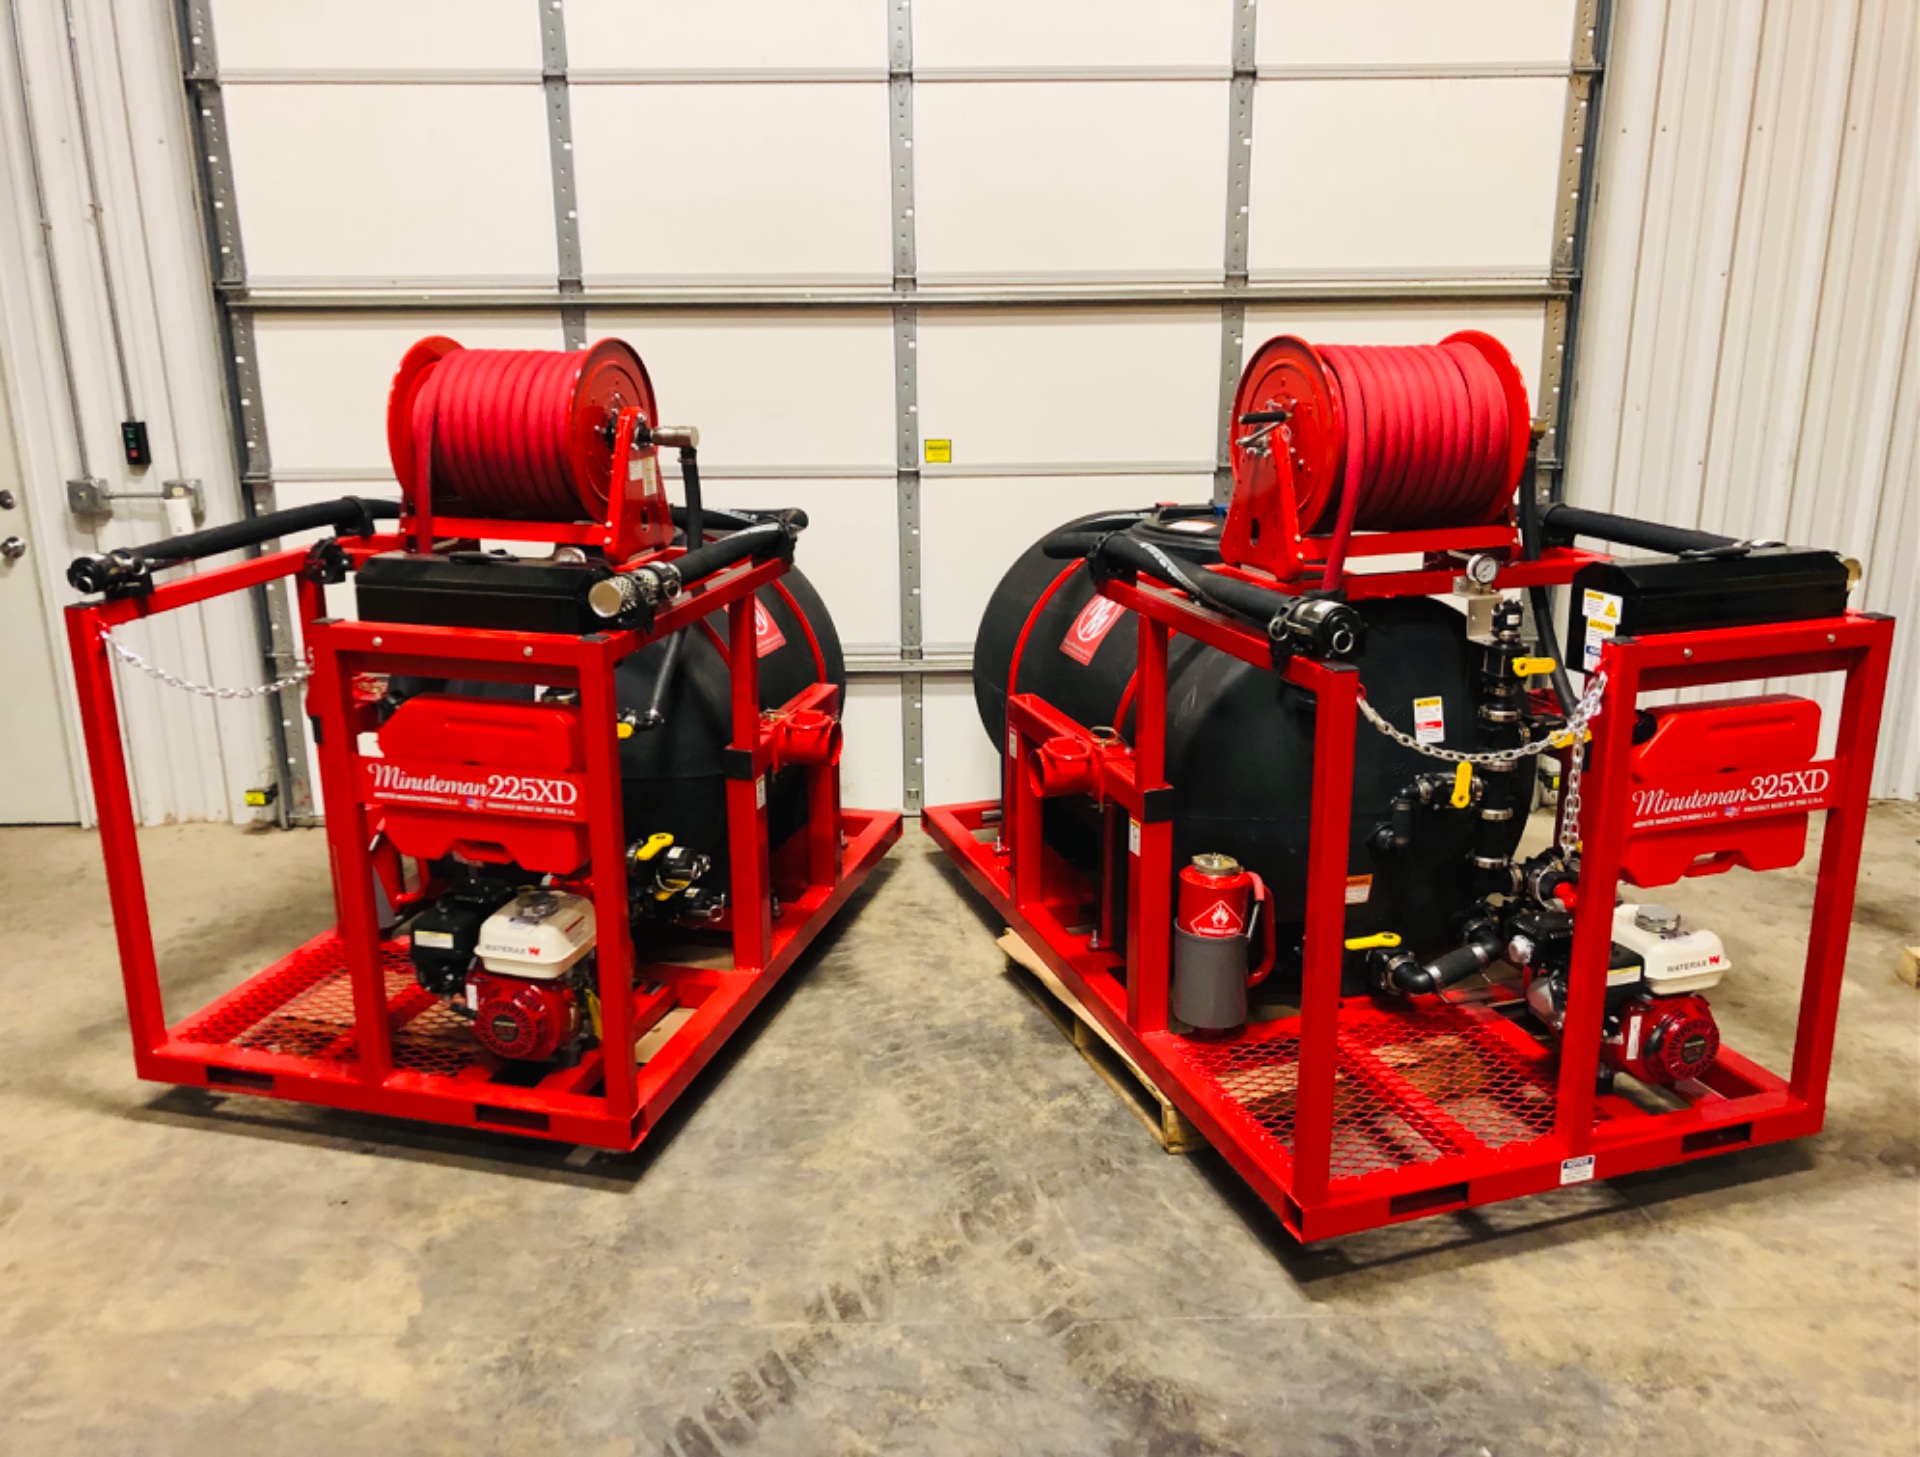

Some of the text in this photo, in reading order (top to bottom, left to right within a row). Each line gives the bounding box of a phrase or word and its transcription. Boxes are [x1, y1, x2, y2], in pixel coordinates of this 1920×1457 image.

[366, 762, 578, 805] Minuteman 225XD
[1631, 768, 1829, 816] Minuteman 325XD
